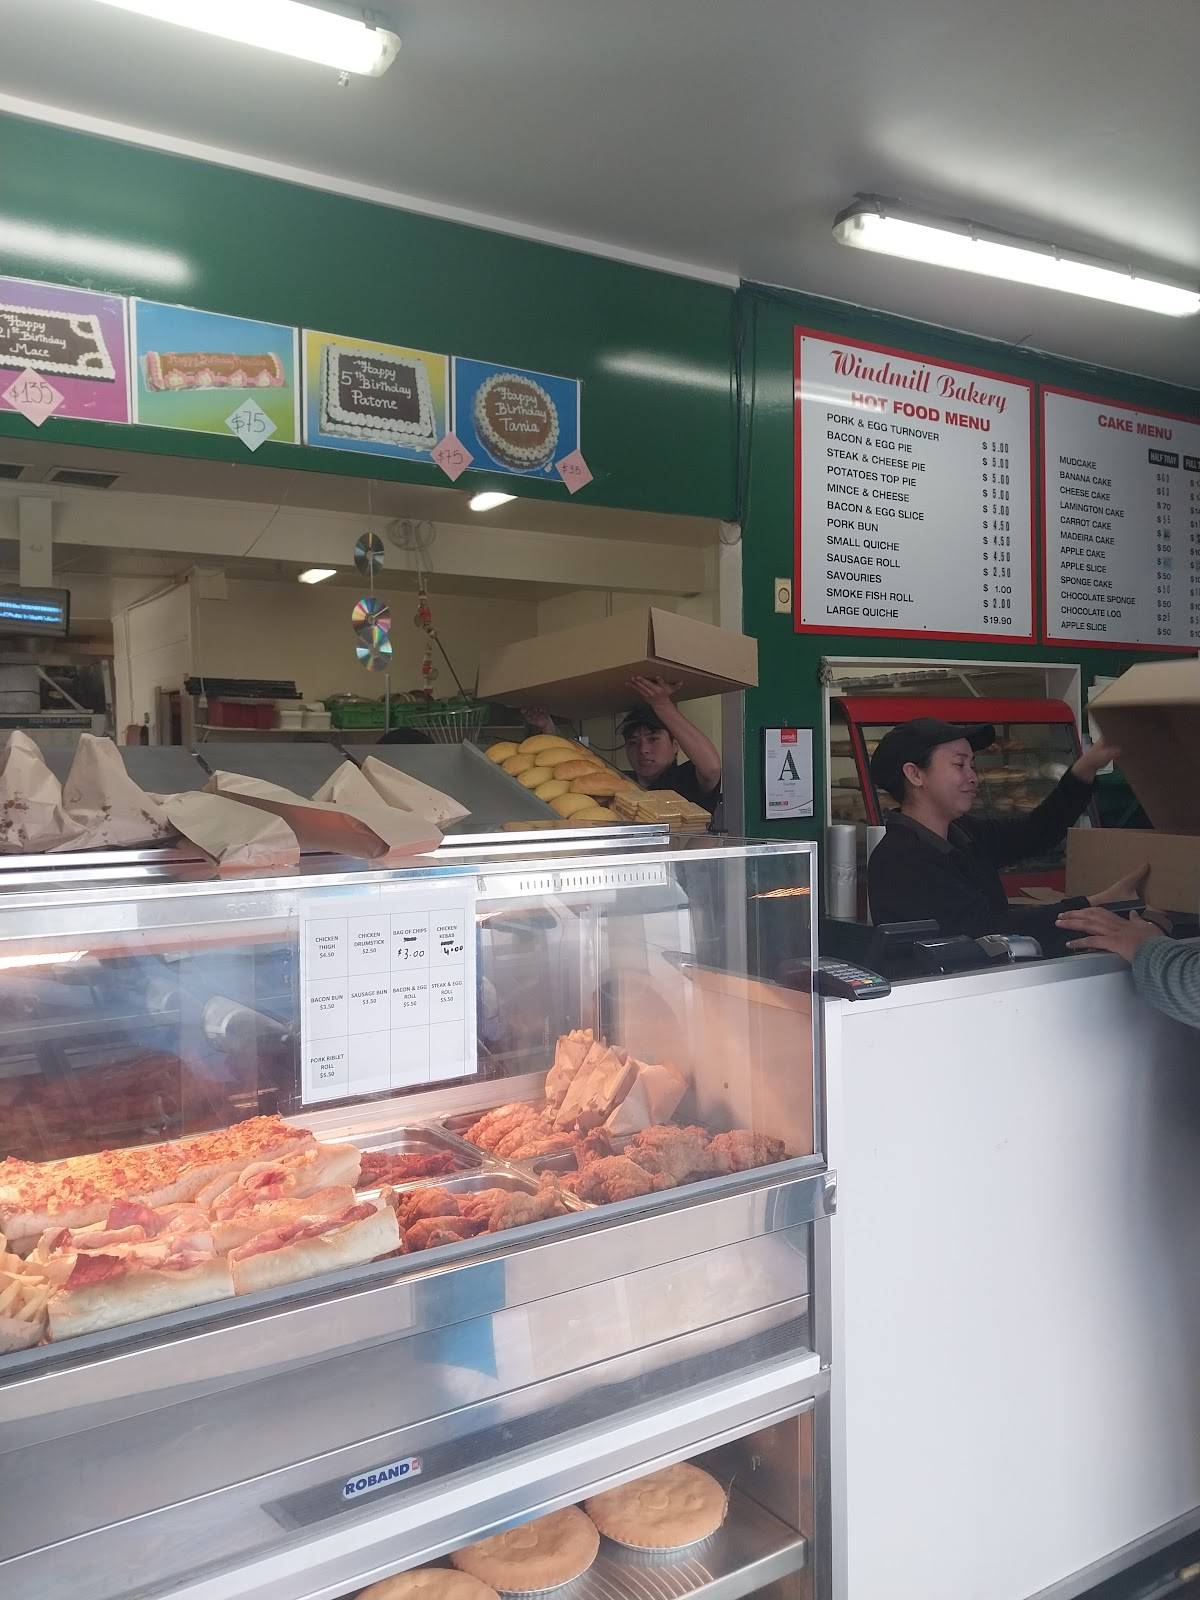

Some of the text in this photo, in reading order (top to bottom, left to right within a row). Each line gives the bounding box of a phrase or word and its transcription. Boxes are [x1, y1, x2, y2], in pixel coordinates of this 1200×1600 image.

[2, 314, 46, 333] Happy
[19, 331, 67, 349] Birthday
[9, 343, 50, 357] Mace
[353, 360, 396, 381] Happy
[359, 378, 411, 399] Birthday
[830, 350, 1007, 413] Windmill Bakery
[11, 381, 54, 404] $135
[351, 390, 398, 409] Patone
[493, 387, 537, 409] Happy
[851, 392, 990, 431] HOT FOOD MENU
[231, 410, 266, 434] $75
[499, 417, 540, 432] Tania
[827, 413, 940, 440] PORK & EGG TURNOVER
[1098, 414, 1173, 441] CAKE MENU
[827, 431, 912, 453] BACON & EGG PIE
[438, 449, 463, 465] $75
[827, 448, 926, 472] STEAK & CHEESE PIE
[1060, 455, 1097, 470] MUDCAKE
[827, 466, 916, 487] POTATOES TOP PIE
[1060, 470, 1112, 487] BANANA CAKE
[827, 483, 909, 502] MINCE & CHEESE
[1060, 486, 1111, 501] CHEESE CAKE
[827, 500, 924, 521] BACON & EGG SLICE
[1060, 501, 1125, 518] LAMINGTON CAKE
[827, 518, 879, 532] PORK BUN
[1060, 516, 1112, 530] CARROT CAKE
[826, 535, 900, 551] SMALL QUICHE
[1060, 531, 1115, 545] MADEIRA CAKE
[1060, 546, 1106, 559] APPLE CAKE
[1156, 544, 1172, 552] $50
[826, 553, 901, 568] SAUSAGE ROLL
[1060, 561, 1107, 573] APPLE SLICE
[826, 570, 882, 583] SAVOURIES
[1060, 576, 1113, 588] SPONGE CAKE
[1156, 571, 1172, 580] $50
[826, 588, 914, 603] SMOKE FISH ROLL
[995, 585, 1011, 594] 1.00
[1060, 591, 1136, 605] CHOCOLATE SPONGE
[1157, 600, 1172, 608] $50
[826, 606, 899, 618] LARGE QUICHE
[1060, 606, 1122, 618] CHOCOLATE LOG
[983, 615, 1011, 625] $19.90
[1061, 620, 1107, 631] APPLE SLICE
[778, 749, 801, 781] A
[315, 935, 339, 943] CHICKEN
[354, 939, 385, 947] DRUMSTICK
[397, 948, 425, 960] $3.00
[310, 995, 330, 1003] BACON
[350, 991, 376, 999] SAUSAGE
[319, 1071, 335, 1079] $5.50
[345, 1463, 410, 1496] ROBAND
